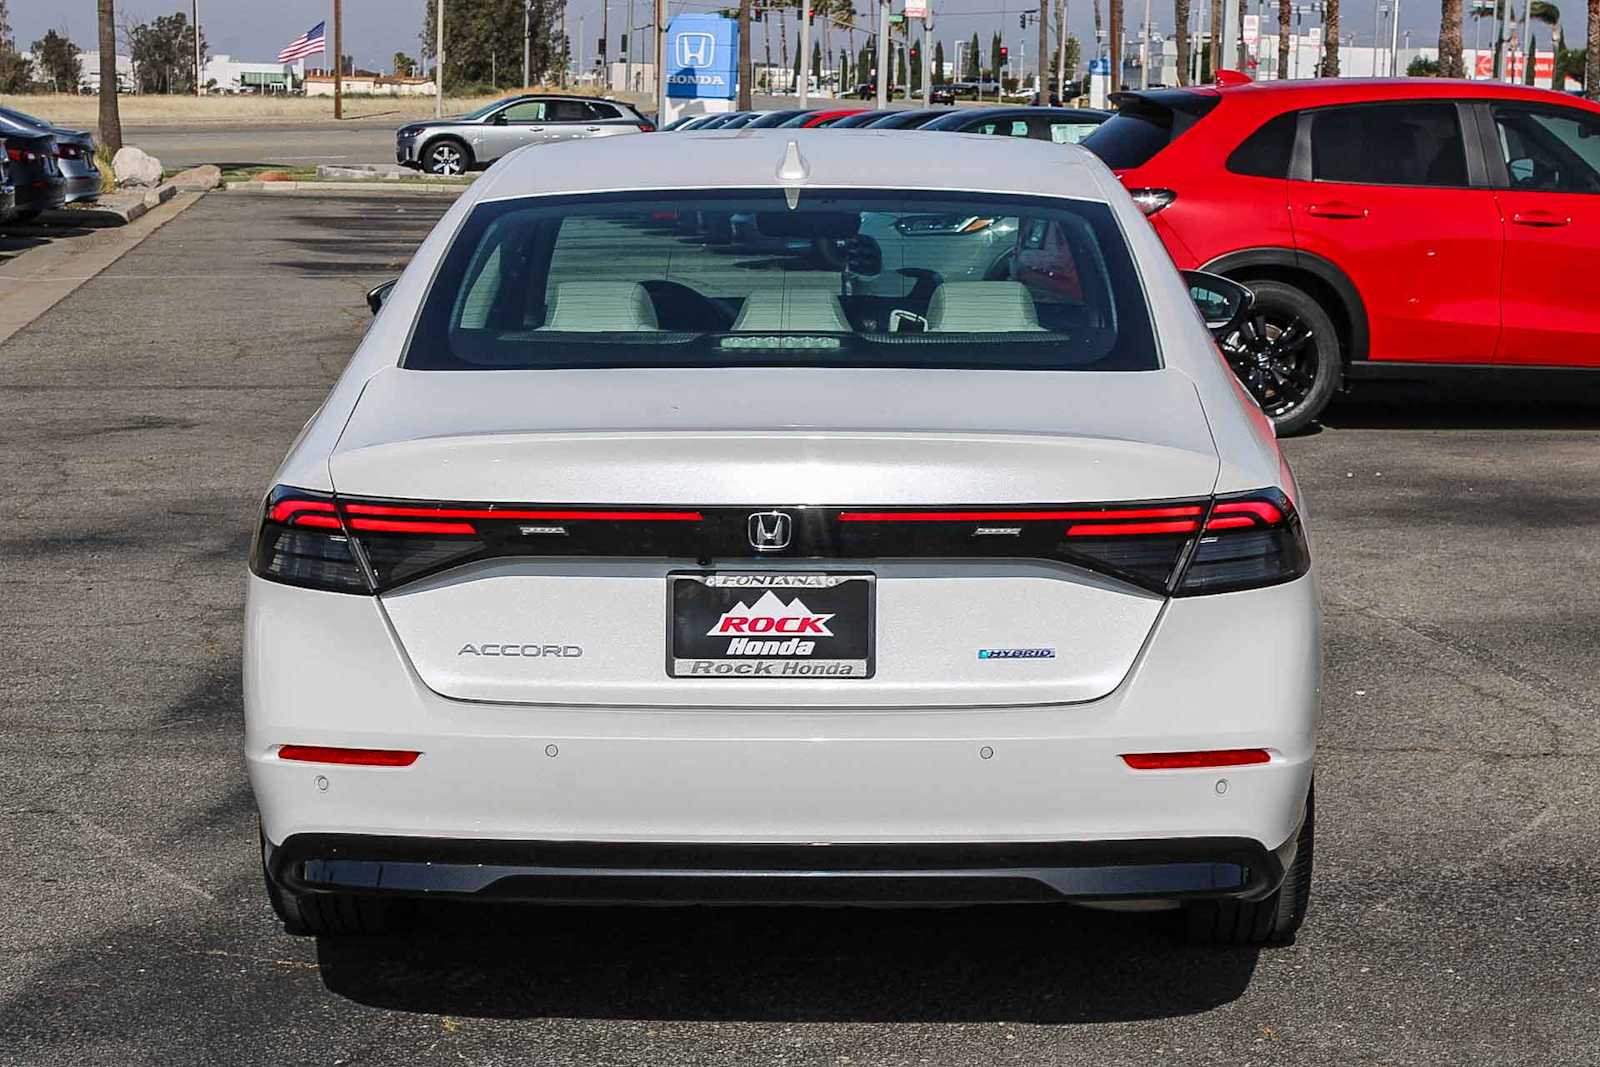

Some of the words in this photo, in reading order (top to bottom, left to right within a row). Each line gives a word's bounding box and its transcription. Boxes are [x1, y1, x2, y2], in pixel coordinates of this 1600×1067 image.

[666, 74, 725, 85] HONDA
[722, 575, 822, 586] FONTANA
[719, 617, 825, 633] ROCK
[457, 643, 584, 658] ACCORD
[726, 638, 816, 656] Honda
[985, 648, 1055, 659] HYBRID
[690, 660, 774, 675] Rock
[781, 661, 854, 676] Honda
